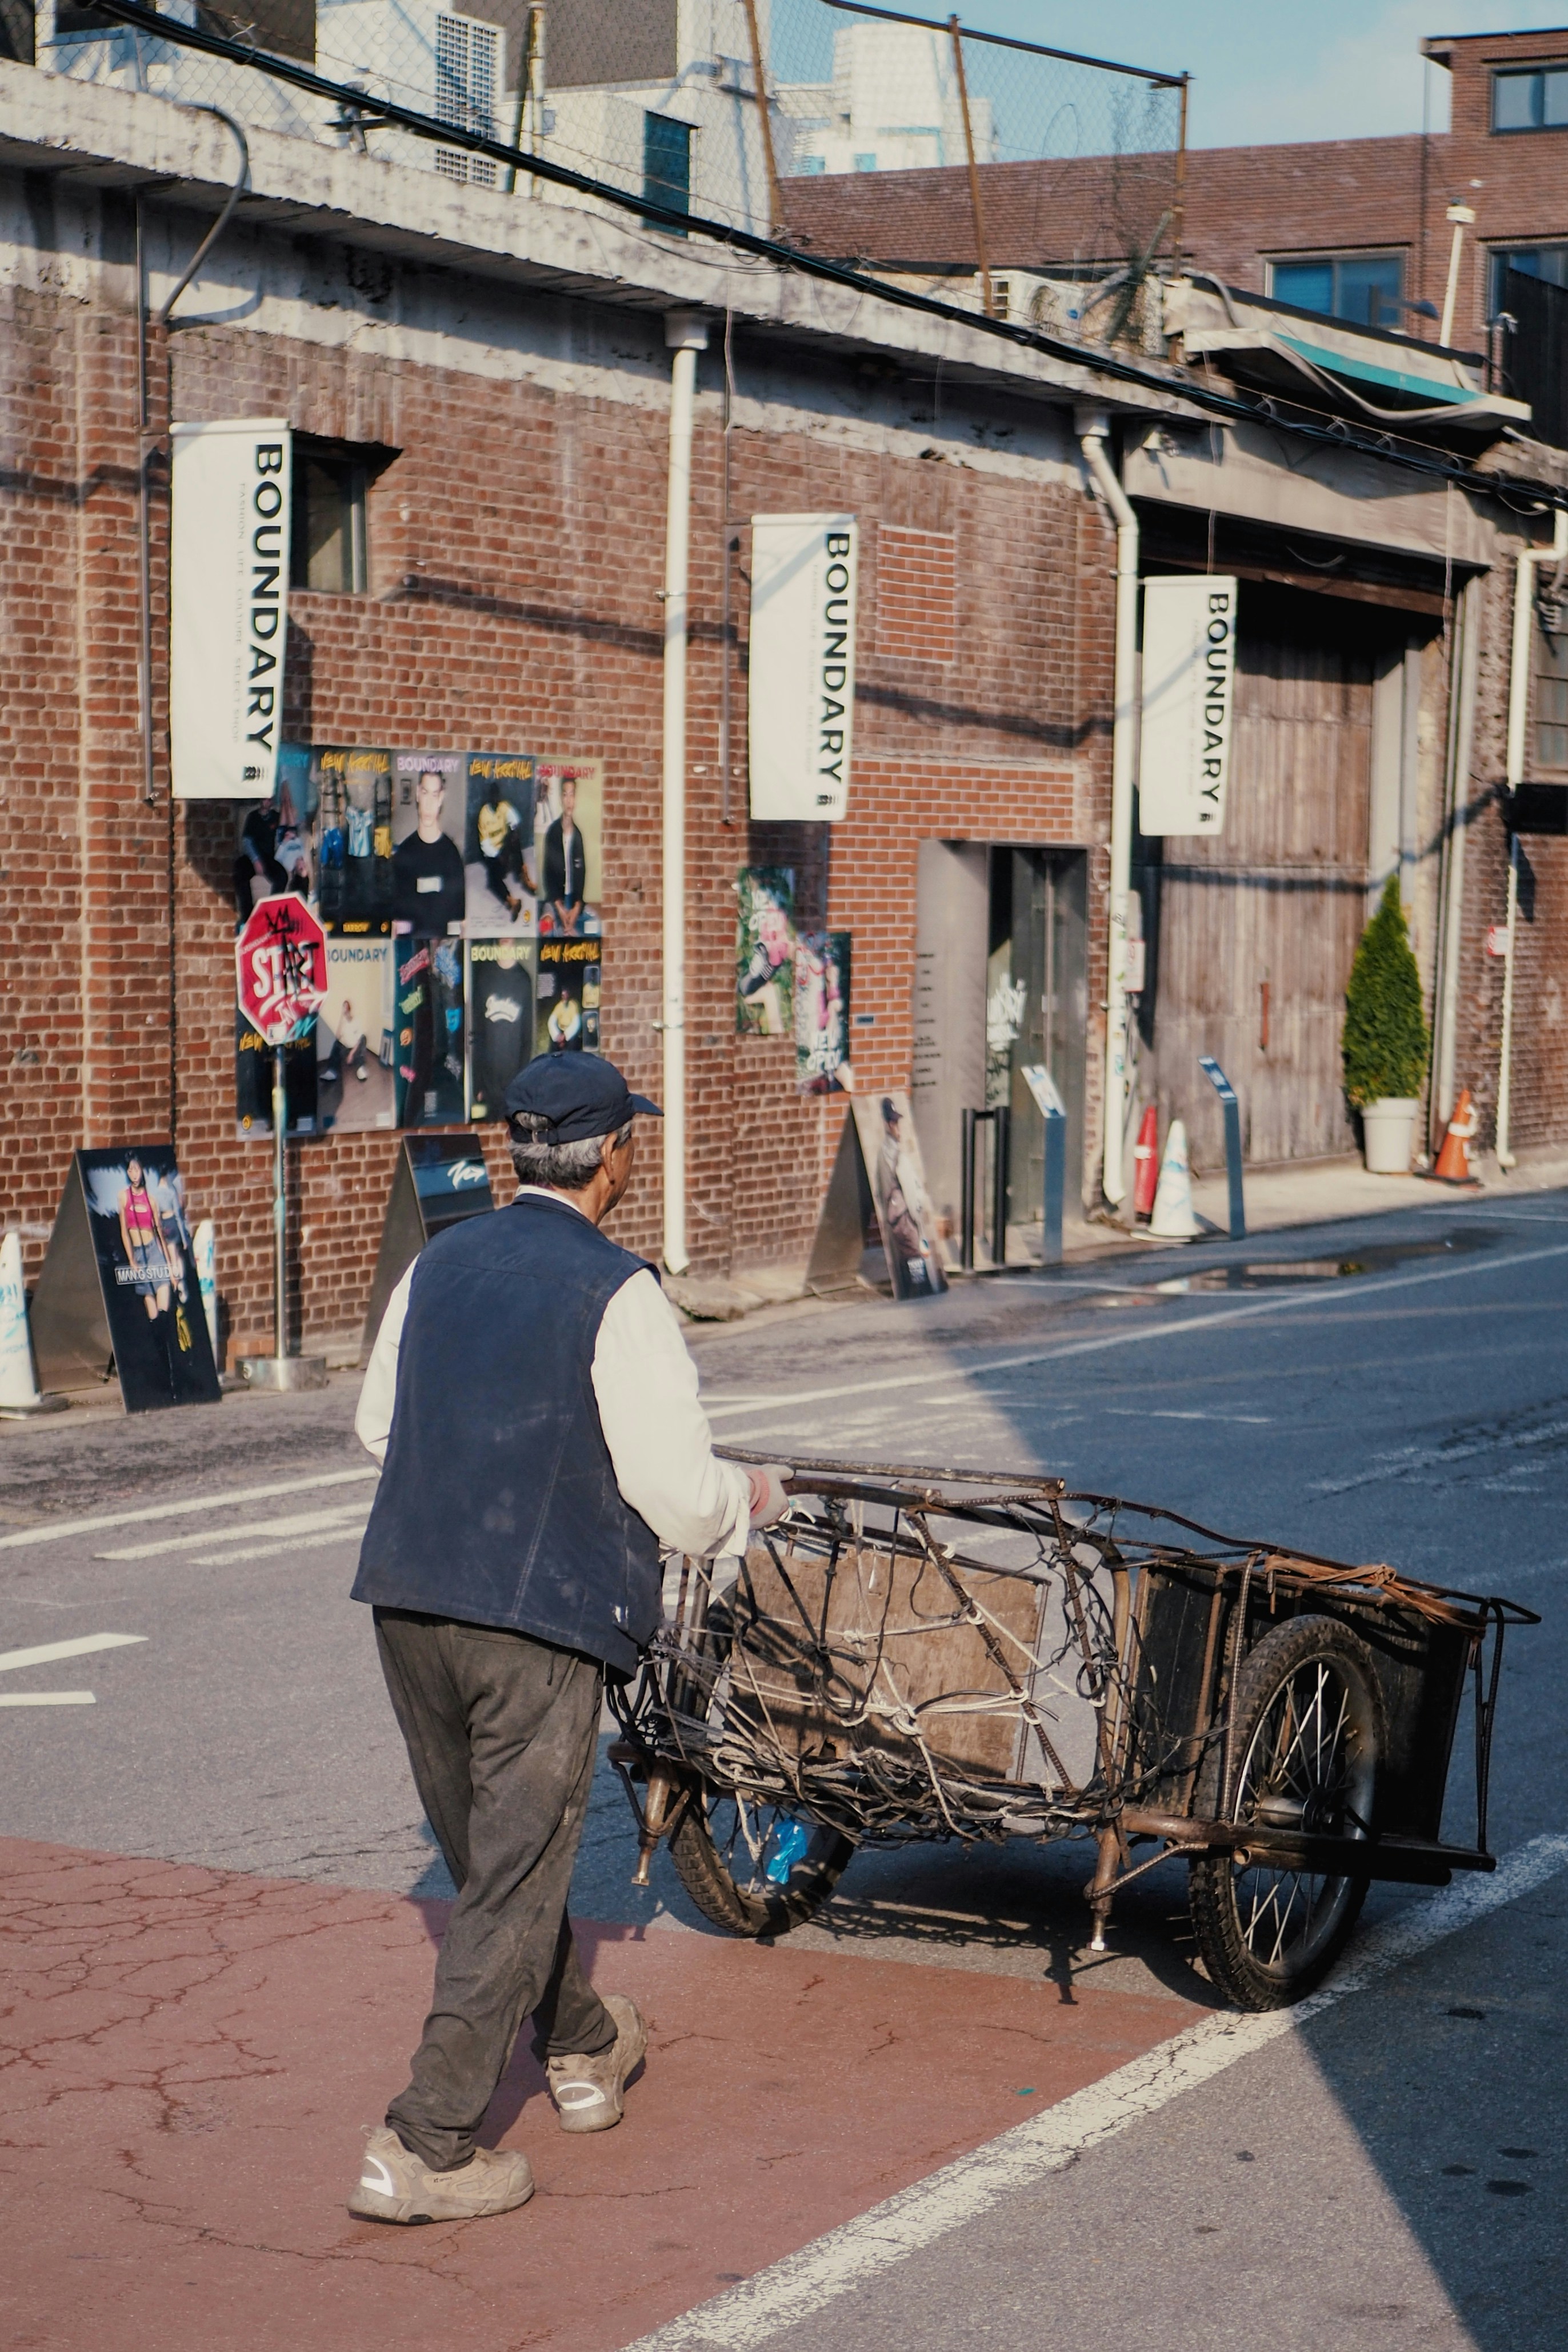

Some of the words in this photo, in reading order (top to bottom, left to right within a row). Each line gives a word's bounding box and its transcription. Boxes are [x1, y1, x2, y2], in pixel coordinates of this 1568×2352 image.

[237, 483, 245, 539] FASHION
[236, 551, 244, 576] LIFE
[247, 444, 282, 755] BOUNDARY
[818, 534, 850, 783] BOUNDARY
[1201, 594, 1229, 802] BOUNDARY
[397, 757, 458, 773] BOUNDARY
[471, 946, 530, 961] BOUNDARY
